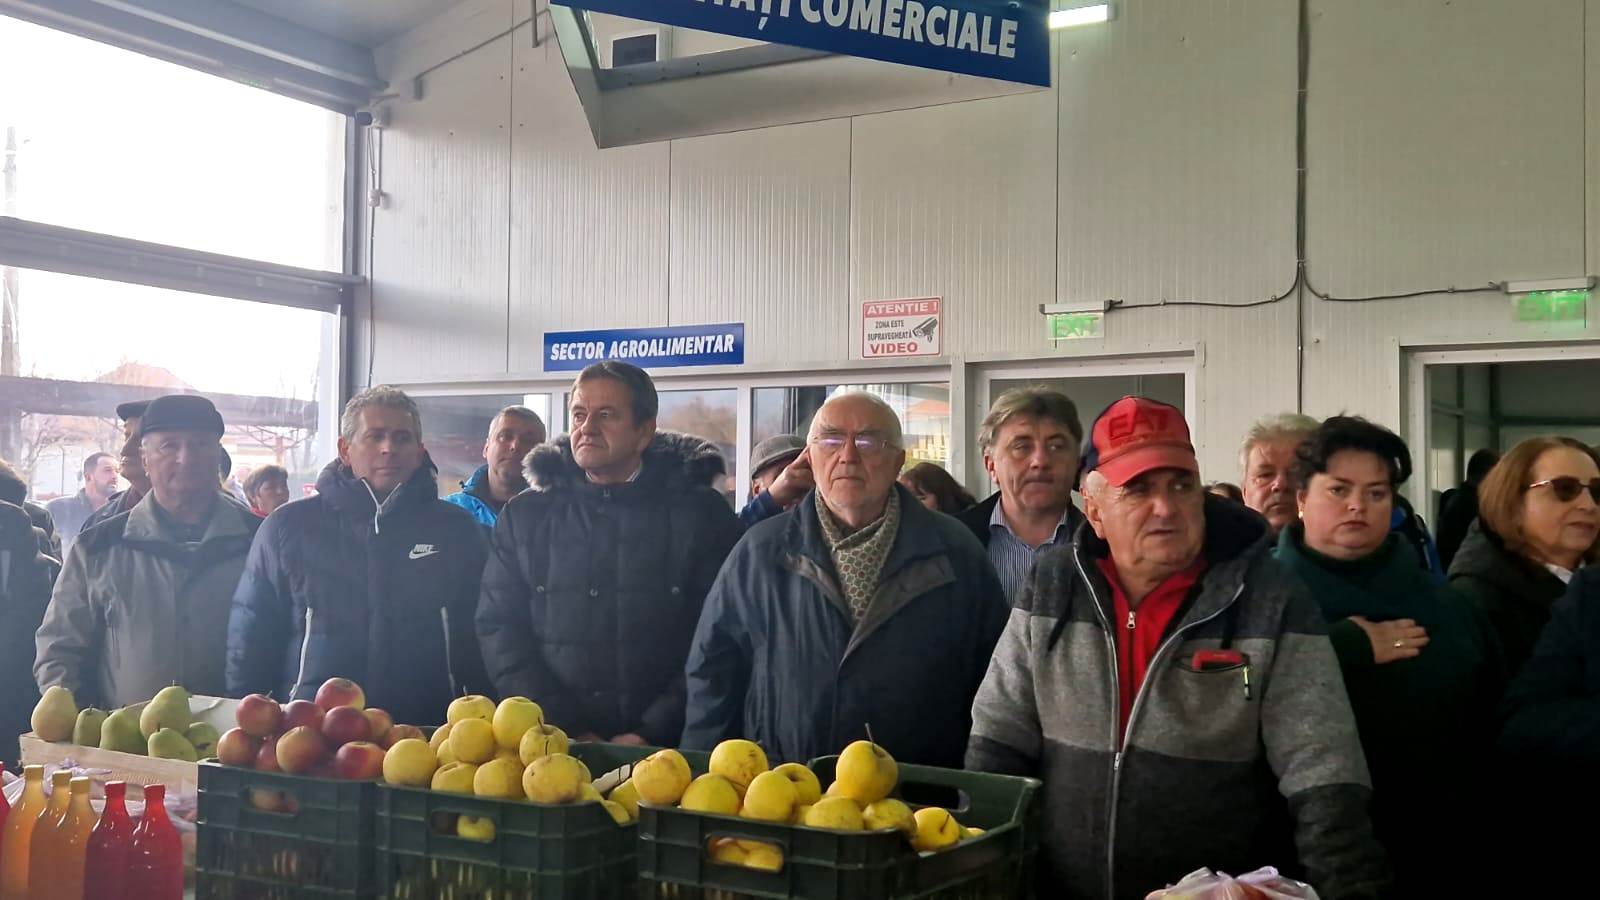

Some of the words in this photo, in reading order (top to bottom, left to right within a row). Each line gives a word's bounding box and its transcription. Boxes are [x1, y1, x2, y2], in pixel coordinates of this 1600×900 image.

[801, 0, 1018, 58] COMERCIALE
[875, 320, 890, 329] ZONA
[891, 319, 905, 328] ESTE
[550, 341, 604, 361] SECTOR
[609, 334, 734, 359] AGROALIMENTAR
[870, 341, 918, 354] VIDEO
